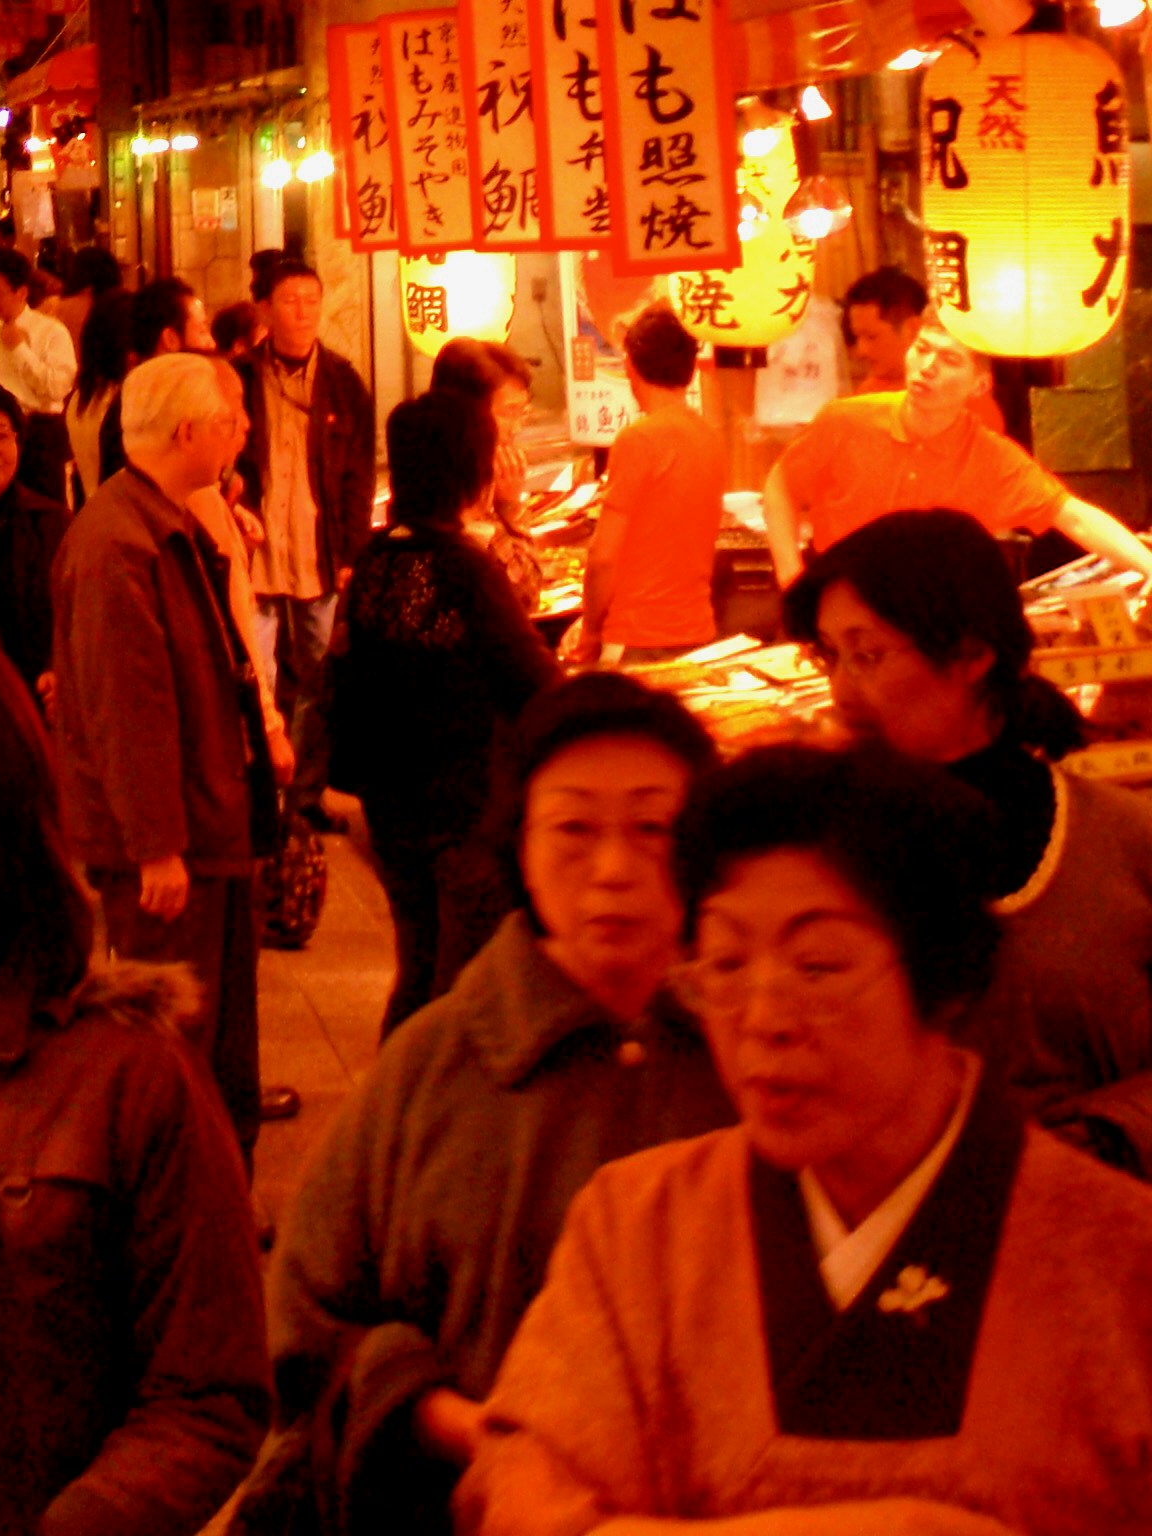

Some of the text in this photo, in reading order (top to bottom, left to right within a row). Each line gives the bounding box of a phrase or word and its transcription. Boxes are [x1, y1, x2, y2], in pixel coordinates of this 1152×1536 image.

[401, 28, 450, 237] はもみそやき
[977, 75, 1026, 151] 天然
